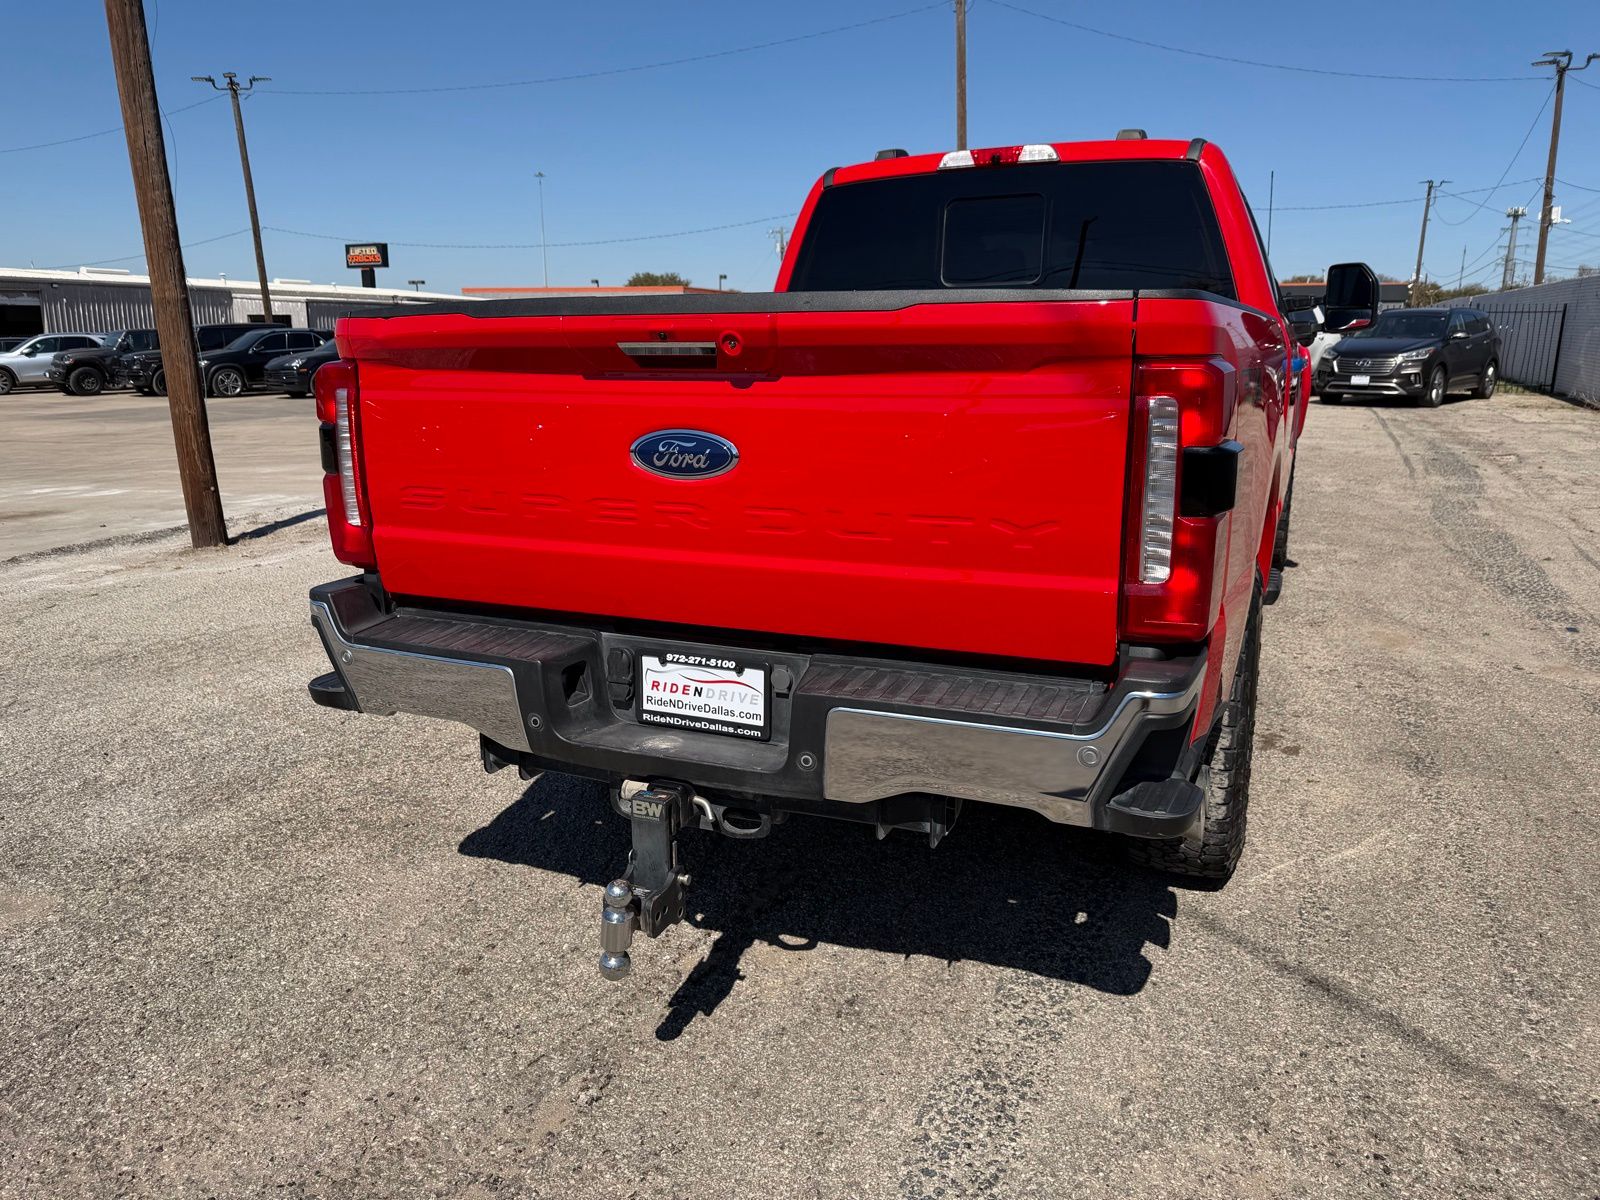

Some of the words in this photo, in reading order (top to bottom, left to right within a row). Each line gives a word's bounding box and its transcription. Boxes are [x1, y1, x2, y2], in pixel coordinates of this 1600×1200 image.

[347, 254, 381, 263] TRUCKS
[350, 246, 377, 255] LIFTED
[653, 439, 710, 469] Ford
[400, 485, 710, 530] SUPER
[743, 504, 1061, 549] DUTY
[665, 653, 736, 669] 972-271-5100
[646, 695, 762, 722] RideNDriveDallas.com
[642, 713, 762, 738] RideNDriveDallas.com
